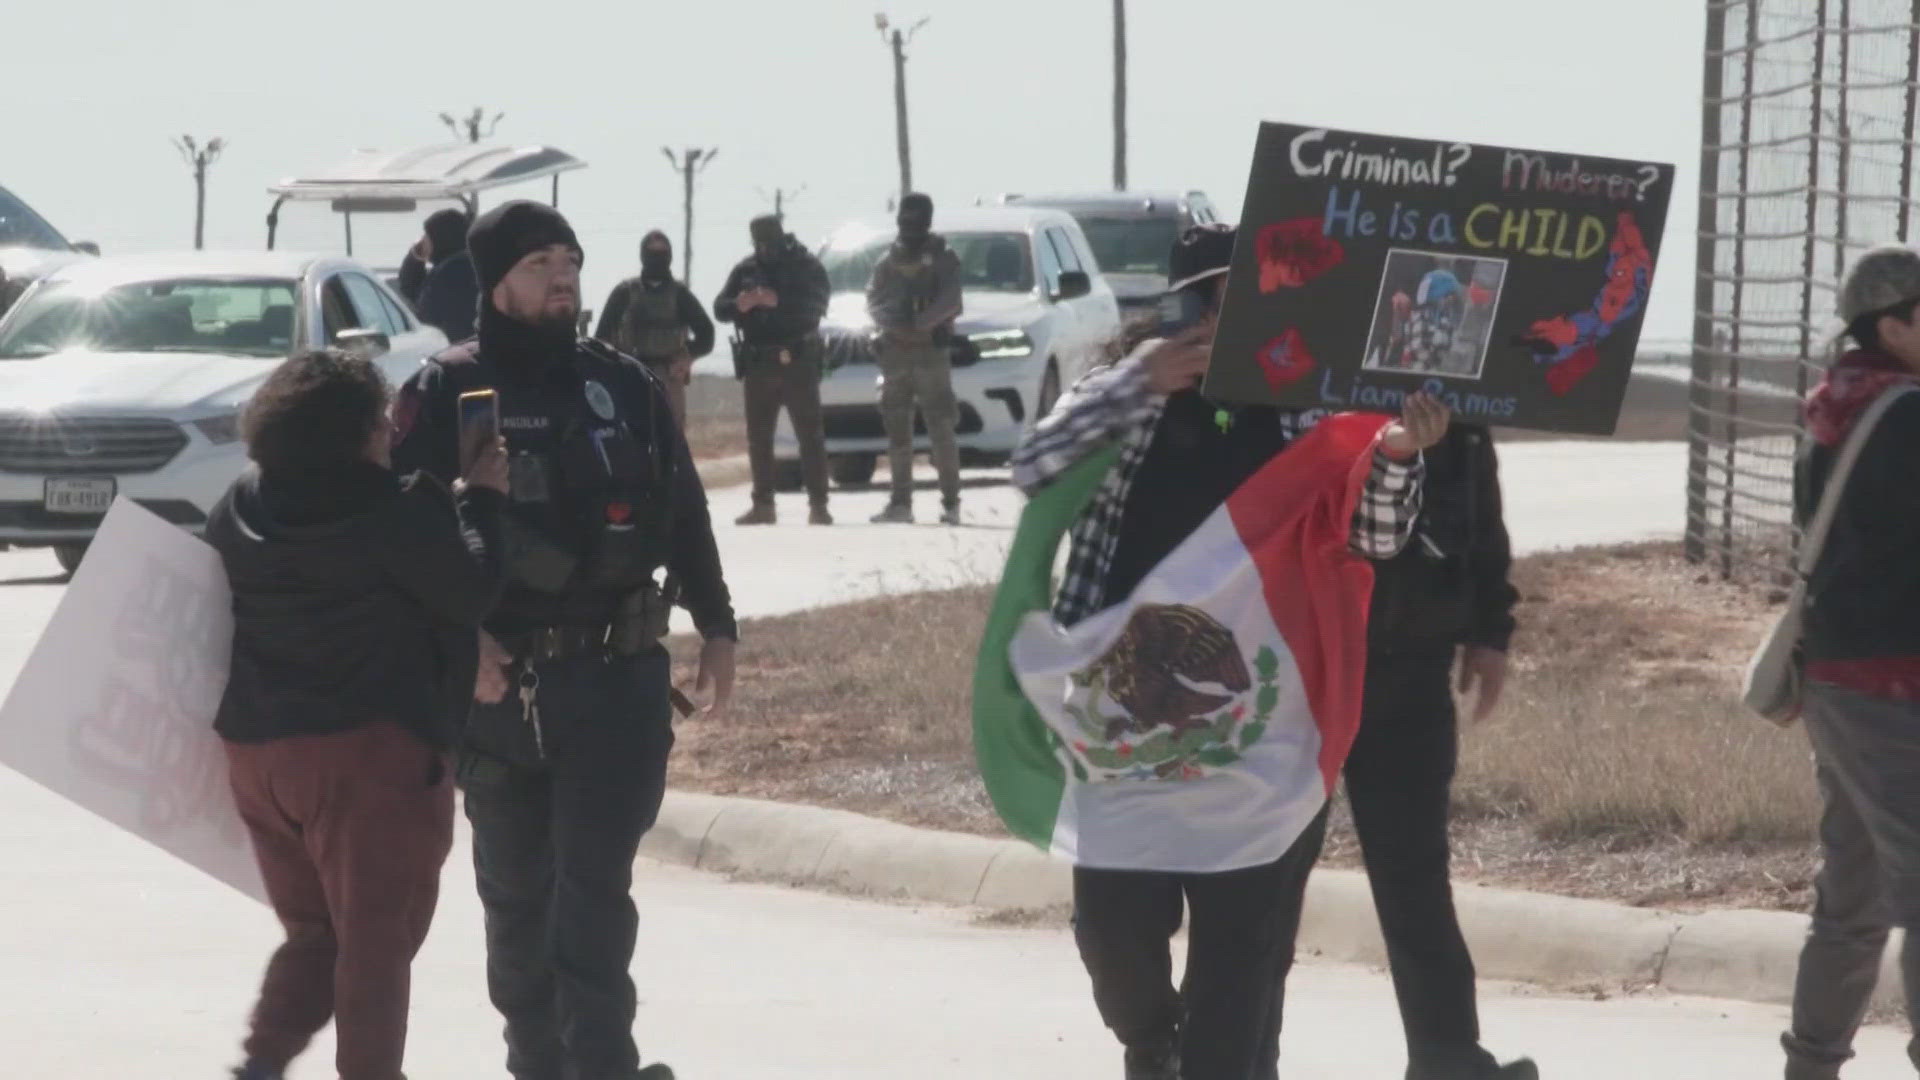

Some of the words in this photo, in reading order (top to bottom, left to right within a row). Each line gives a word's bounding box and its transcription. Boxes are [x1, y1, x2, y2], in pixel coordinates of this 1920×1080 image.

[1289, 128, 1472, 187] Criminal?
[1322, 185, 1376, 237] He
[1388, 201, 1420, 240] is
[1427, 212, 1457, 244] a
[1464, 203, 1606, 260] CHILD
[1320, 367, 1406, 408] Liam
